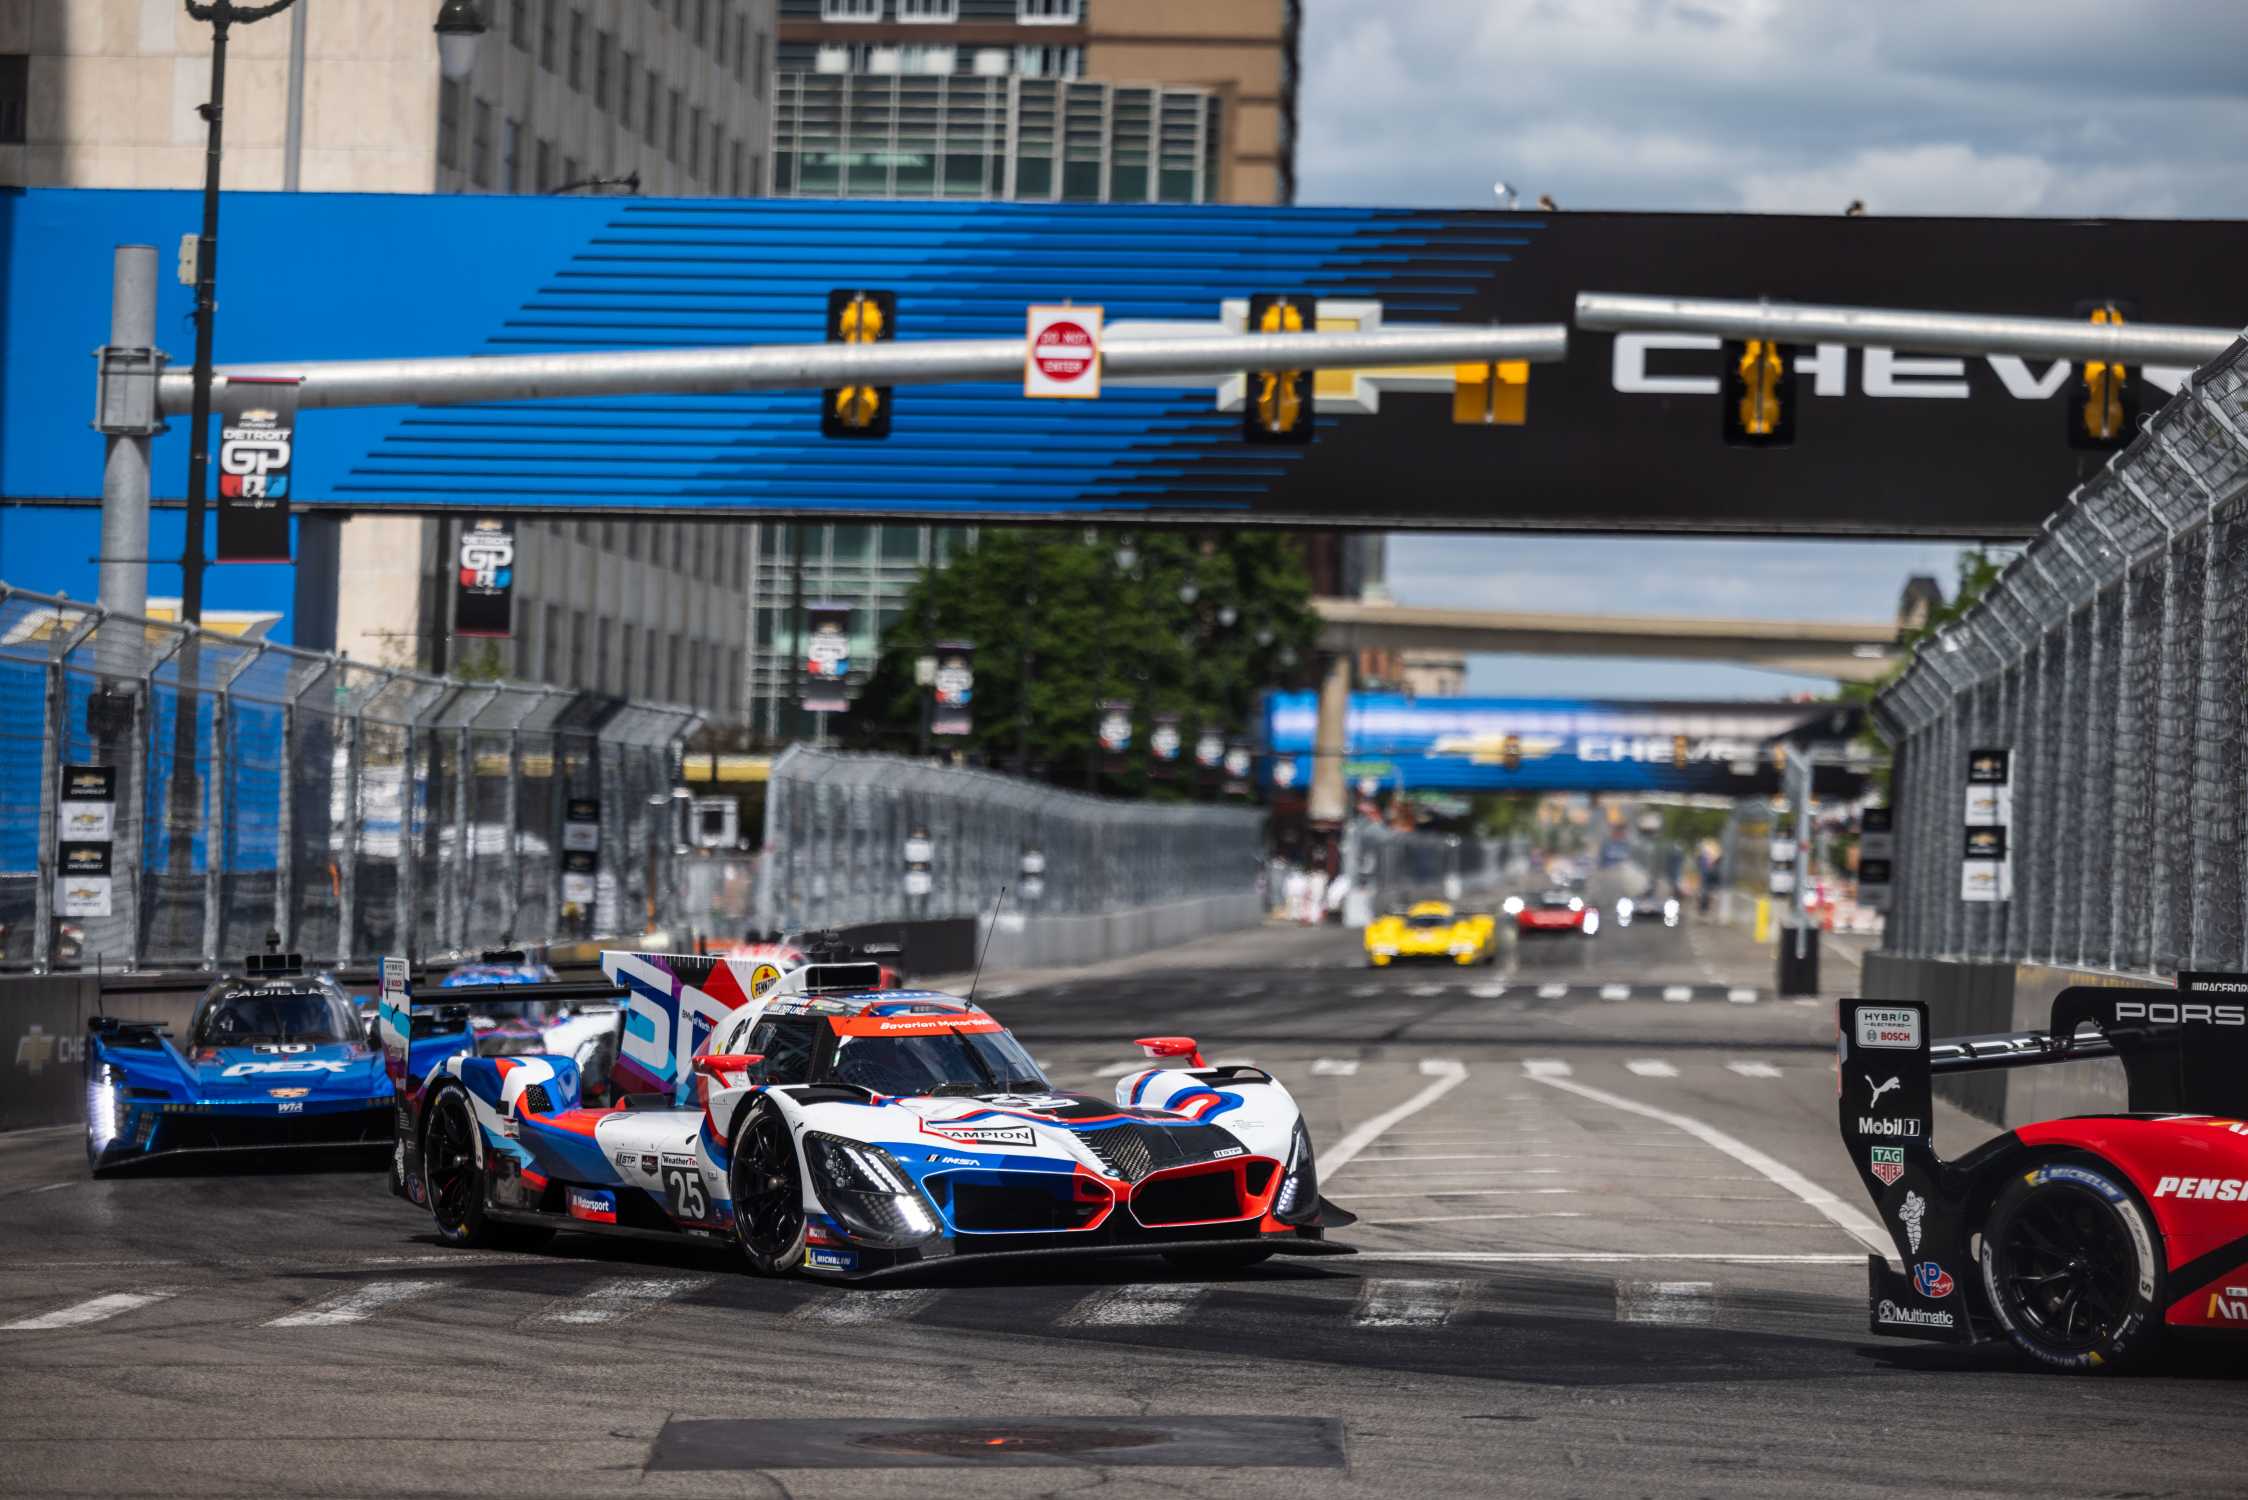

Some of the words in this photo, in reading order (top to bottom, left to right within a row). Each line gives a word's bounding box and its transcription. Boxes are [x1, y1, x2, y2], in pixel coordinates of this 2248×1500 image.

[1043, 361, 1083, 373] ENTER
[1613, 332, 2200, 398] CHEV
[223, 428, 291, 440] DETROIT
[222, 440, 290, 475] GP
[461, 545, 513, 570] GP
[224, 985, 335, 999] CADILLAC
[1864, 1011, 1910, 1022] HYBRID
[2116, 1002, 2245, 1025] PORS
[880, 1020, 937, 1031] Bavarian
[1880, 1031, 1911, 1041] BOSCH
[278, 1103, 304, 1114] WTR
[1858, 1116, 1902, 1136] Mobil
[942, 1131, 1029, 1140] AMPION
[941, 1155, 981, 1166] IMSA
[1874, 1149, 1901, 1163] TAG
[1873, 1164, 1903, 1183] HEUER
[670, 1170, 705, 1220] 25
[816, 1255, 851, 1264] MICHELIN
[1896, 1306, 1954, 1325] Multimatic
